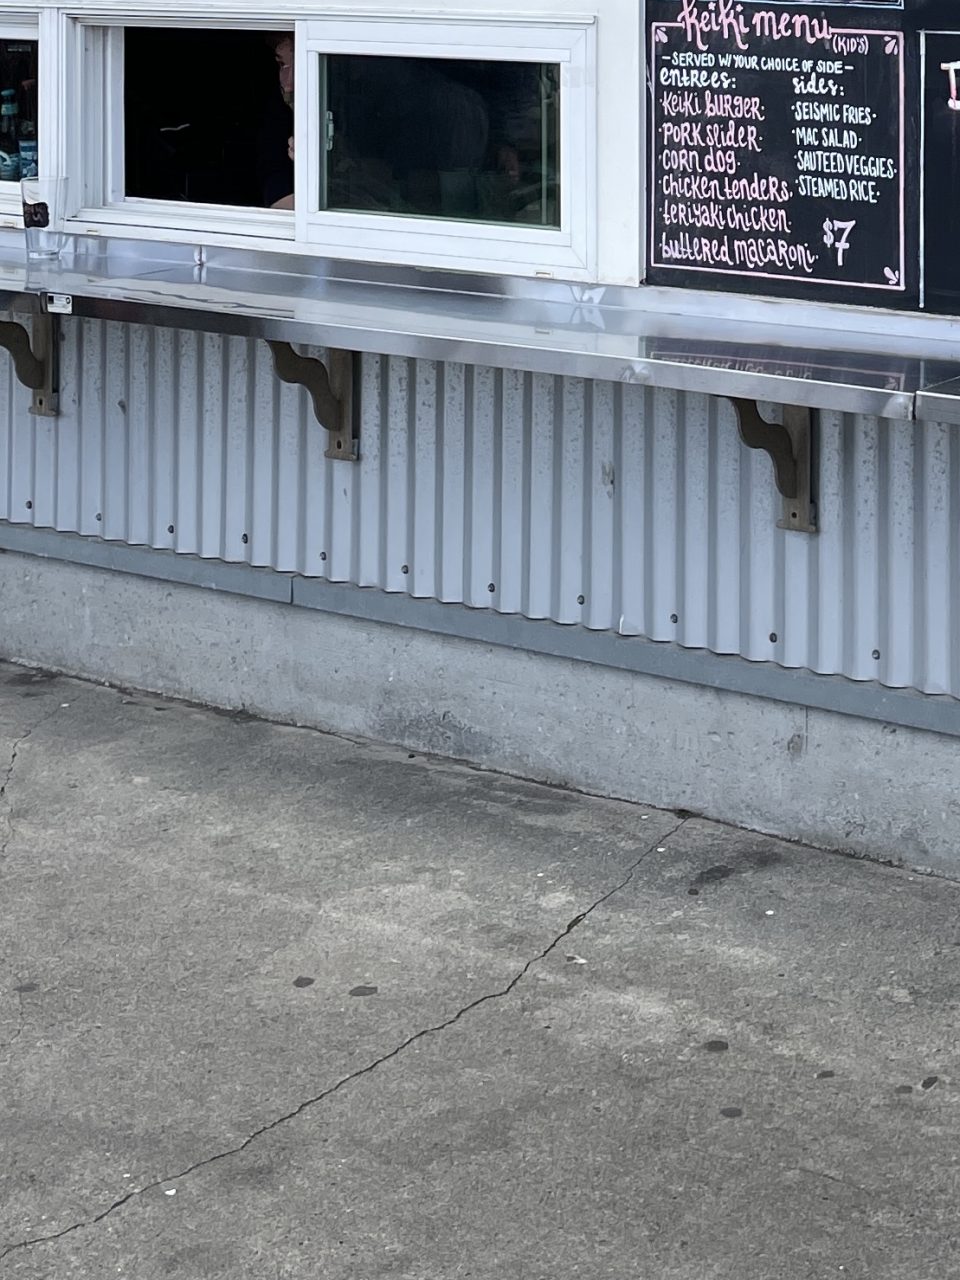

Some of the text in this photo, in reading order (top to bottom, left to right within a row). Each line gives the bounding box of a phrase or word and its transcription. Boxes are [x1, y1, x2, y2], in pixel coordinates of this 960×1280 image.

[752, 9, 832, 44] menu
[733, 54, 814, 72] YOUR CHOICE OF
[794, 101, 841, 121] SEISMIC
[796, 127, 819, 147] MAC
[797, 151, 845, 172] SAUTEED
[798, 175, 848, 200] STEAMED
[822, 217, 857, 266] $7
